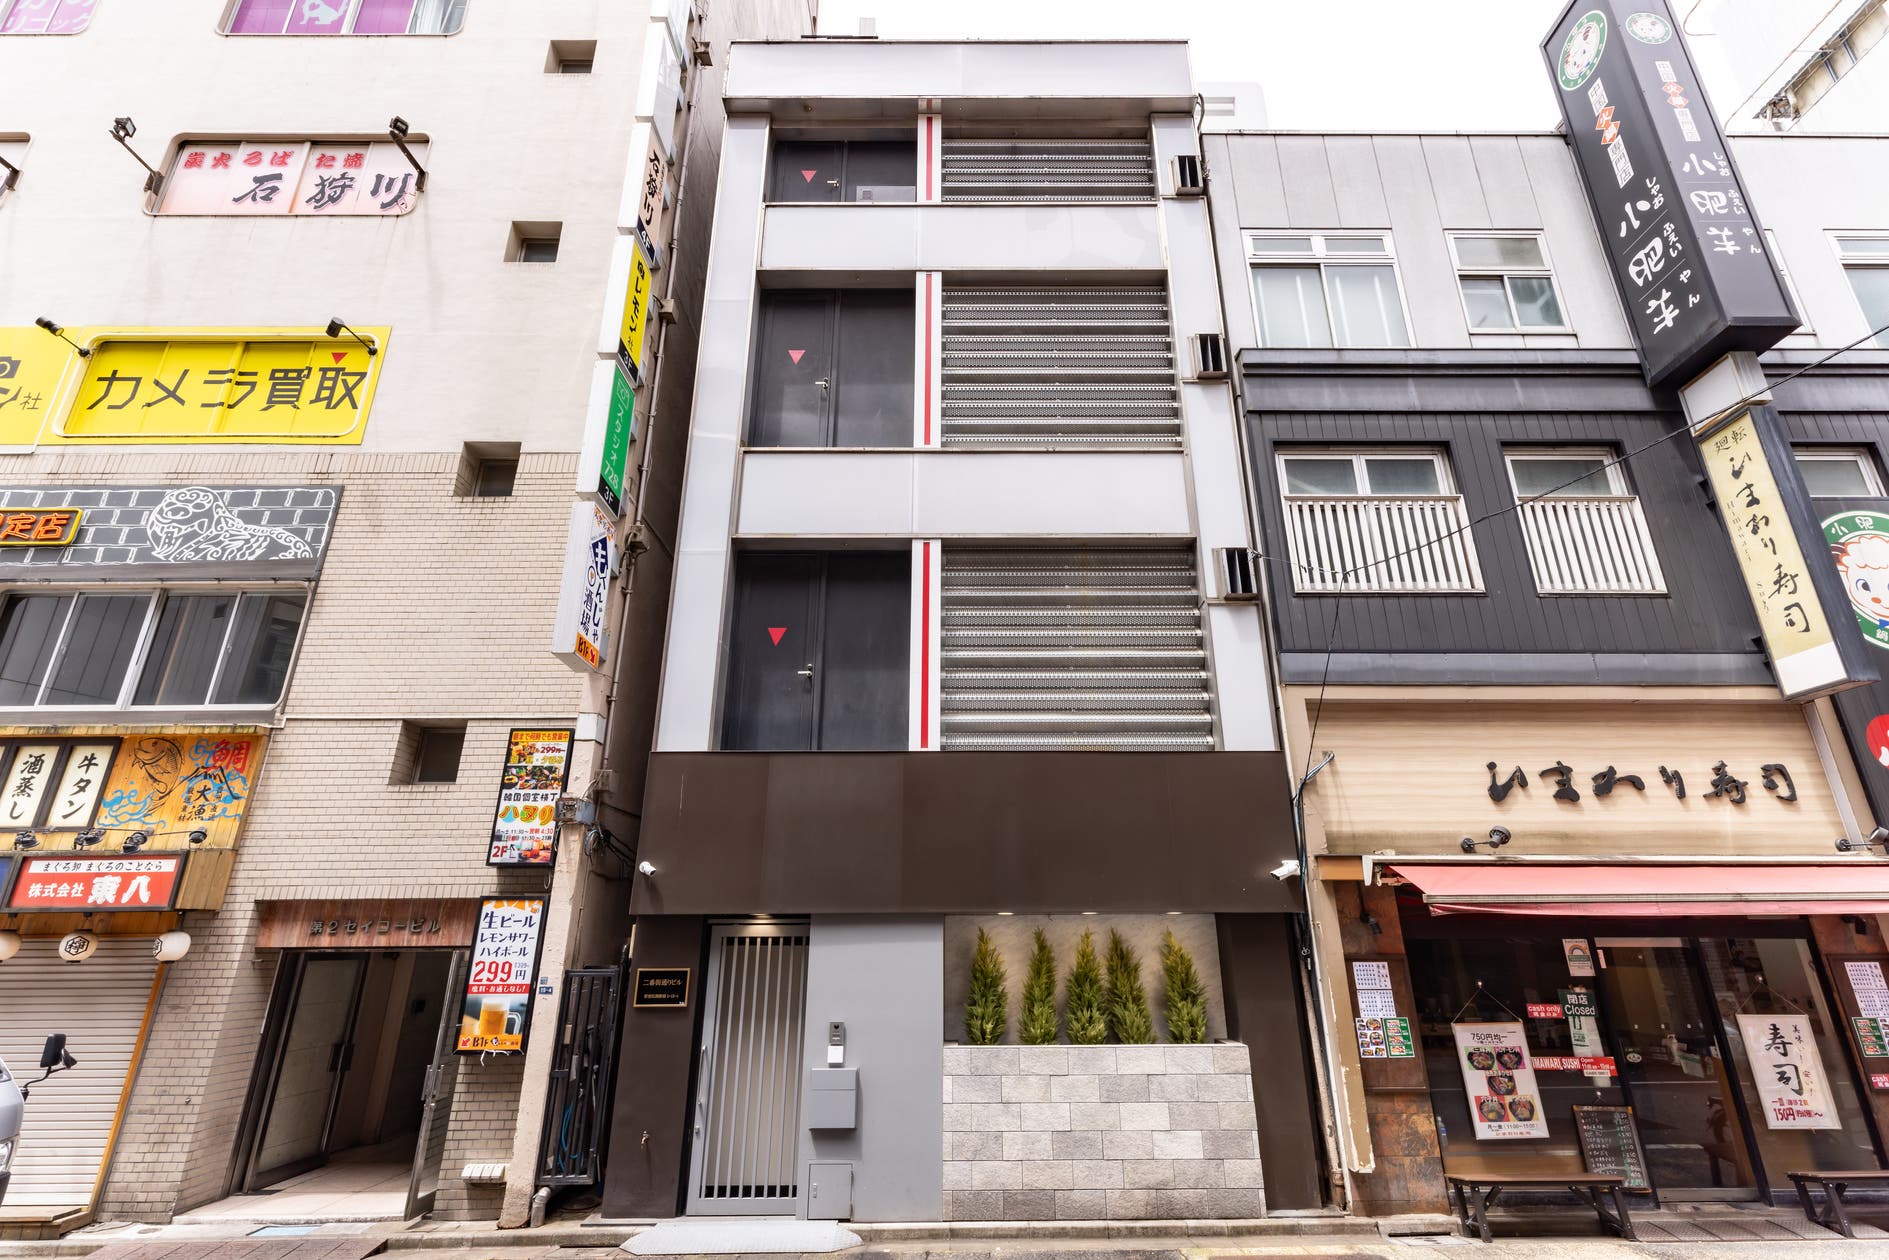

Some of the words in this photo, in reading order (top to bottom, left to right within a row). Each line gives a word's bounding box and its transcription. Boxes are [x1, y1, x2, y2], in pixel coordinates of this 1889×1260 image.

[184, 150, 365, 169] 炭火ろばた焼
[232, 172, 415, 210] 石狩川
[643, 149, 661, 226] 石狩川
[1645, 176, 1664, 210] しゃお
[1679, 269, 1700, 308] やん
[87, 366, 367, 411] カメラ買取
[610, 404, 624, 467] スタジオ
[605, 460, 619, 490] 728
[604, 487, 614, 504] 3F
[0, 512, 70, 540] 定店
[1729, 451, 1811, 634] ひまわり寿司
[212, 739, 251, 774] 鯛
[10, 753, 45, 820] 酒蒸し
[62, 752, 99, 820] 牛タン
[1487, 760, 1798, 804] ひまわり寿司
[503, 792, 558, 802] 韓国個室横丁
[499, 805, 555, 826] ハヌリ
[492, 845, 508, 858] 2F
[43, 862, 82, 872] まぐろ卸
[86, 861, 163, 872] まぐろのことなら
[28, 882, 84, 898] 株式会社
[481, 911, 537, 929] 生ビール
[480, 932, 535, 943] レモンサワー
[480, 946, 529, 957] ハイボール
[473, 960, 512, 982] 299
[515, 969, 526, 980] 円
[1546, 1005, 1561, 1014] only
[1564, 1004, 1596, 1016] Closed
[1567, 994, 1588, 1005] 閉店
[1471, 1033, 1508, 1041] 750円均一
[1764, 1023, 1804, 1096] 寿司
